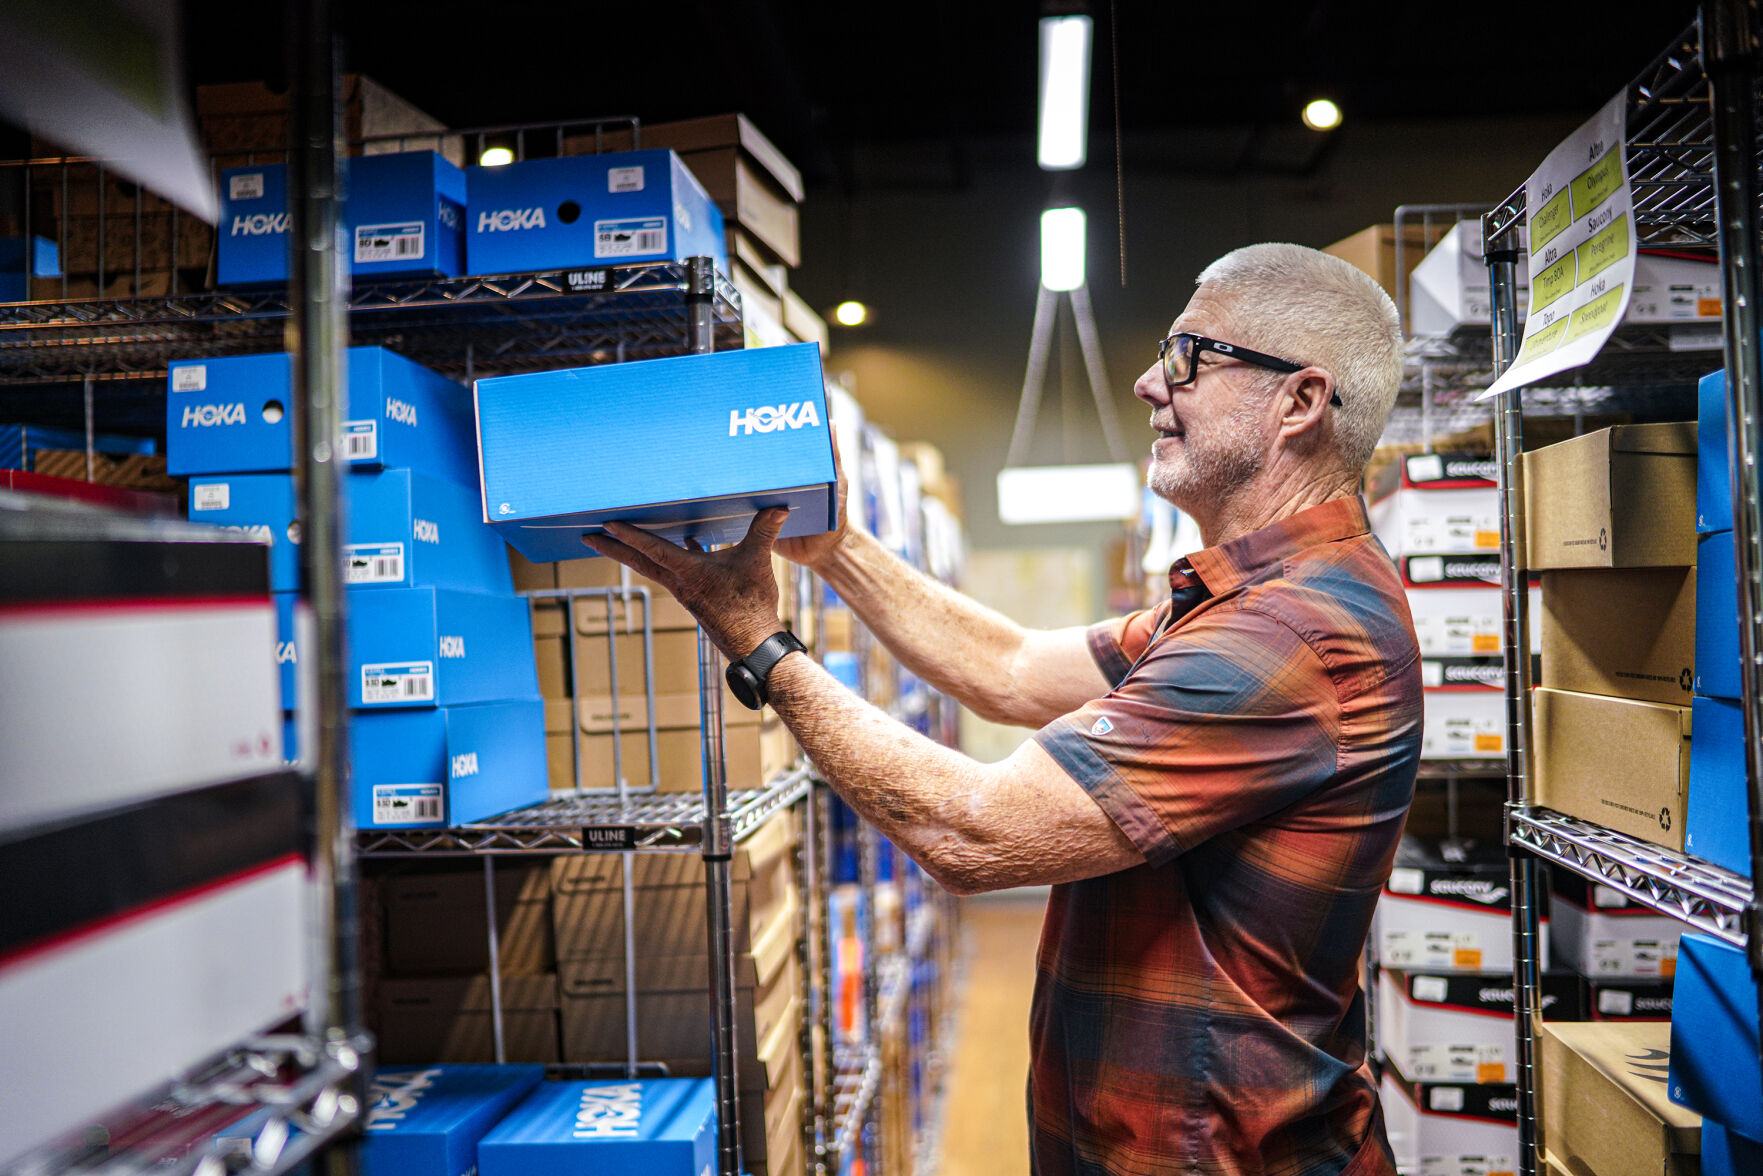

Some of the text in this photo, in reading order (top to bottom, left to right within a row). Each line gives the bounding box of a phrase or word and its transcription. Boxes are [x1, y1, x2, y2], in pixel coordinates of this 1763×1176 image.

[1588, 140, 1604, 162] Altra
[1541, 183, 1553, 202] Hoka
[477, 207, 546, 233] HOKA
[1587, 206, 1613, 233] Saucony
[1544, 247, 1558, 266] Altra
[568, 271, 606, 284] ULINE
[1591, 278, 1606, 297] Hoka
[181, 403, 247, 428] HOKA
[386, 397, 417, 427] HOKA
[728, 400, 821, 437] HOKA
[413, 518, 439, 544] HOKA
[439, 636, 465, 658] HOKA
[451, 752, 478, 778] HOKA
[588, 828, 627, 843] ULINE
[573, 1083, 643, 1138] HOKA
